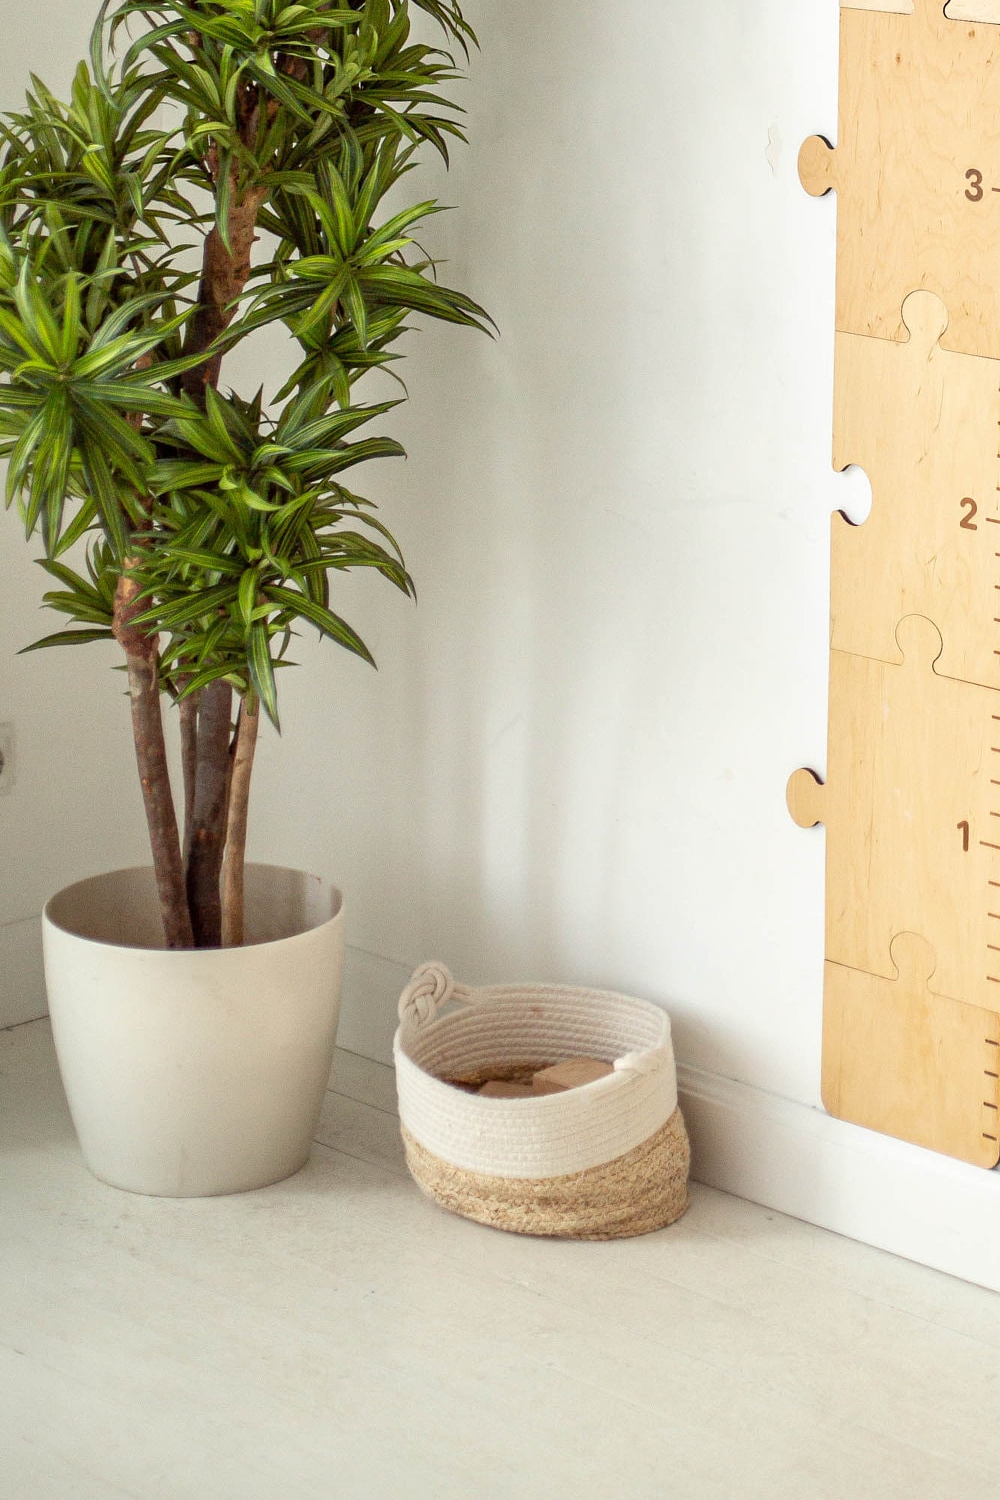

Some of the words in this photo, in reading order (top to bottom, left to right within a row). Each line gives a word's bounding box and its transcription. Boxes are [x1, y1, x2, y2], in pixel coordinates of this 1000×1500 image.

[964, 168, 984, 202] 3
[959, 497, 978, 531] 2
[956, 820, 970, 852] 1
